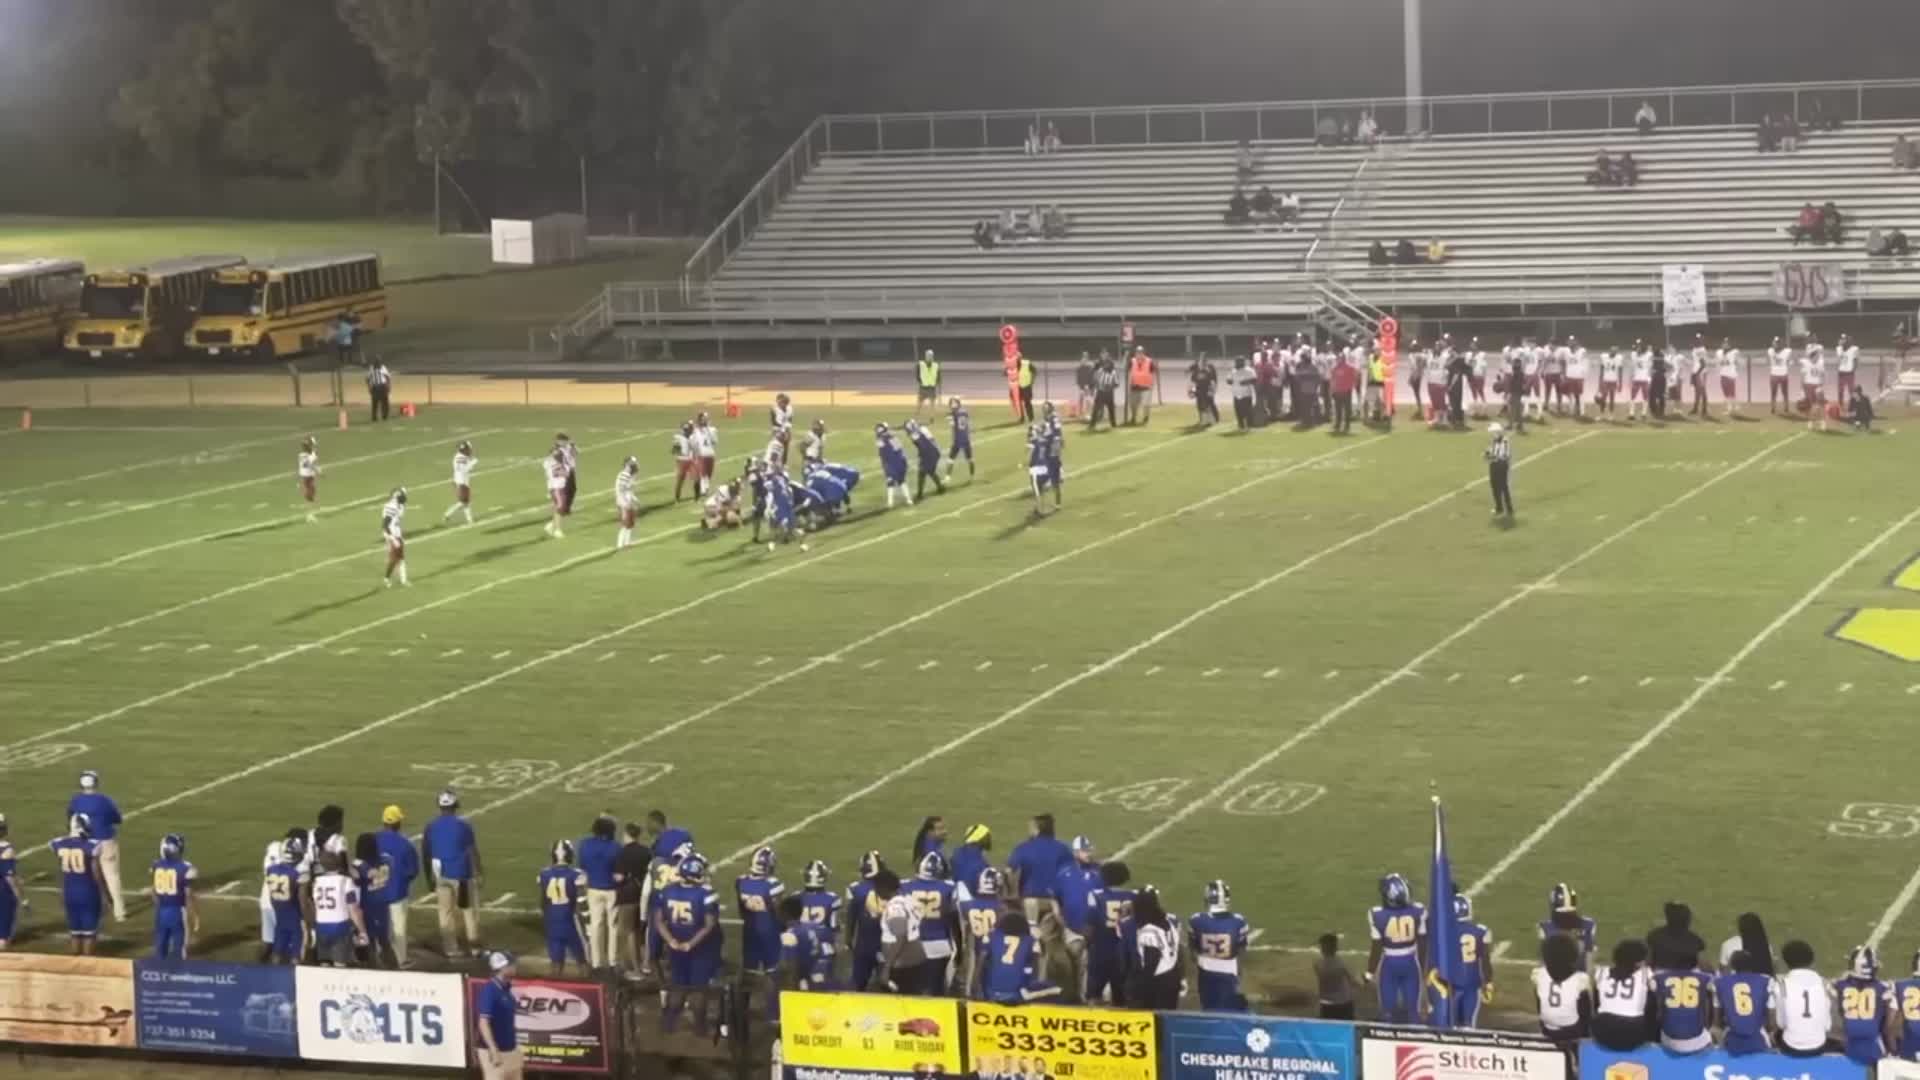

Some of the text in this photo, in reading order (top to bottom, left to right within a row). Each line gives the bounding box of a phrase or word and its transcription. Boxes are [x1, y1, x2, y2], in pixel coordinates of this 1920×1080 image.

[315, 885, 338, 911] 25
[545, 876, 569, 905] 41
[666, 900, 694, 925] 75
[911, 889, 943, 920] 52
[1384, 915, 1417, 943] 40
[1002, 935, 1022, 965] 7
[1200, 933, 1233, 960] 53
[1548, 983, 1562, 1009] 6
[1604, 974, 1636, 1000] 39
[1664, 977, 1701, 1009] 36
[1733, 983, 1754, 1017] 6
[1801, 990, 1812, 1019] 1
[1841, 988, 1876, 1020] 20
[972, 1012, 1151, 1037] CAR WRECK?
[997, 1032, 1148, 1059] 333-3333
[1180, 1053, 1340, 1075] CHESAPEAKE REGIONAL
[1438, 1049, 1505, 1072] Stitch
[1513, 1058, 1529, 1074] It
